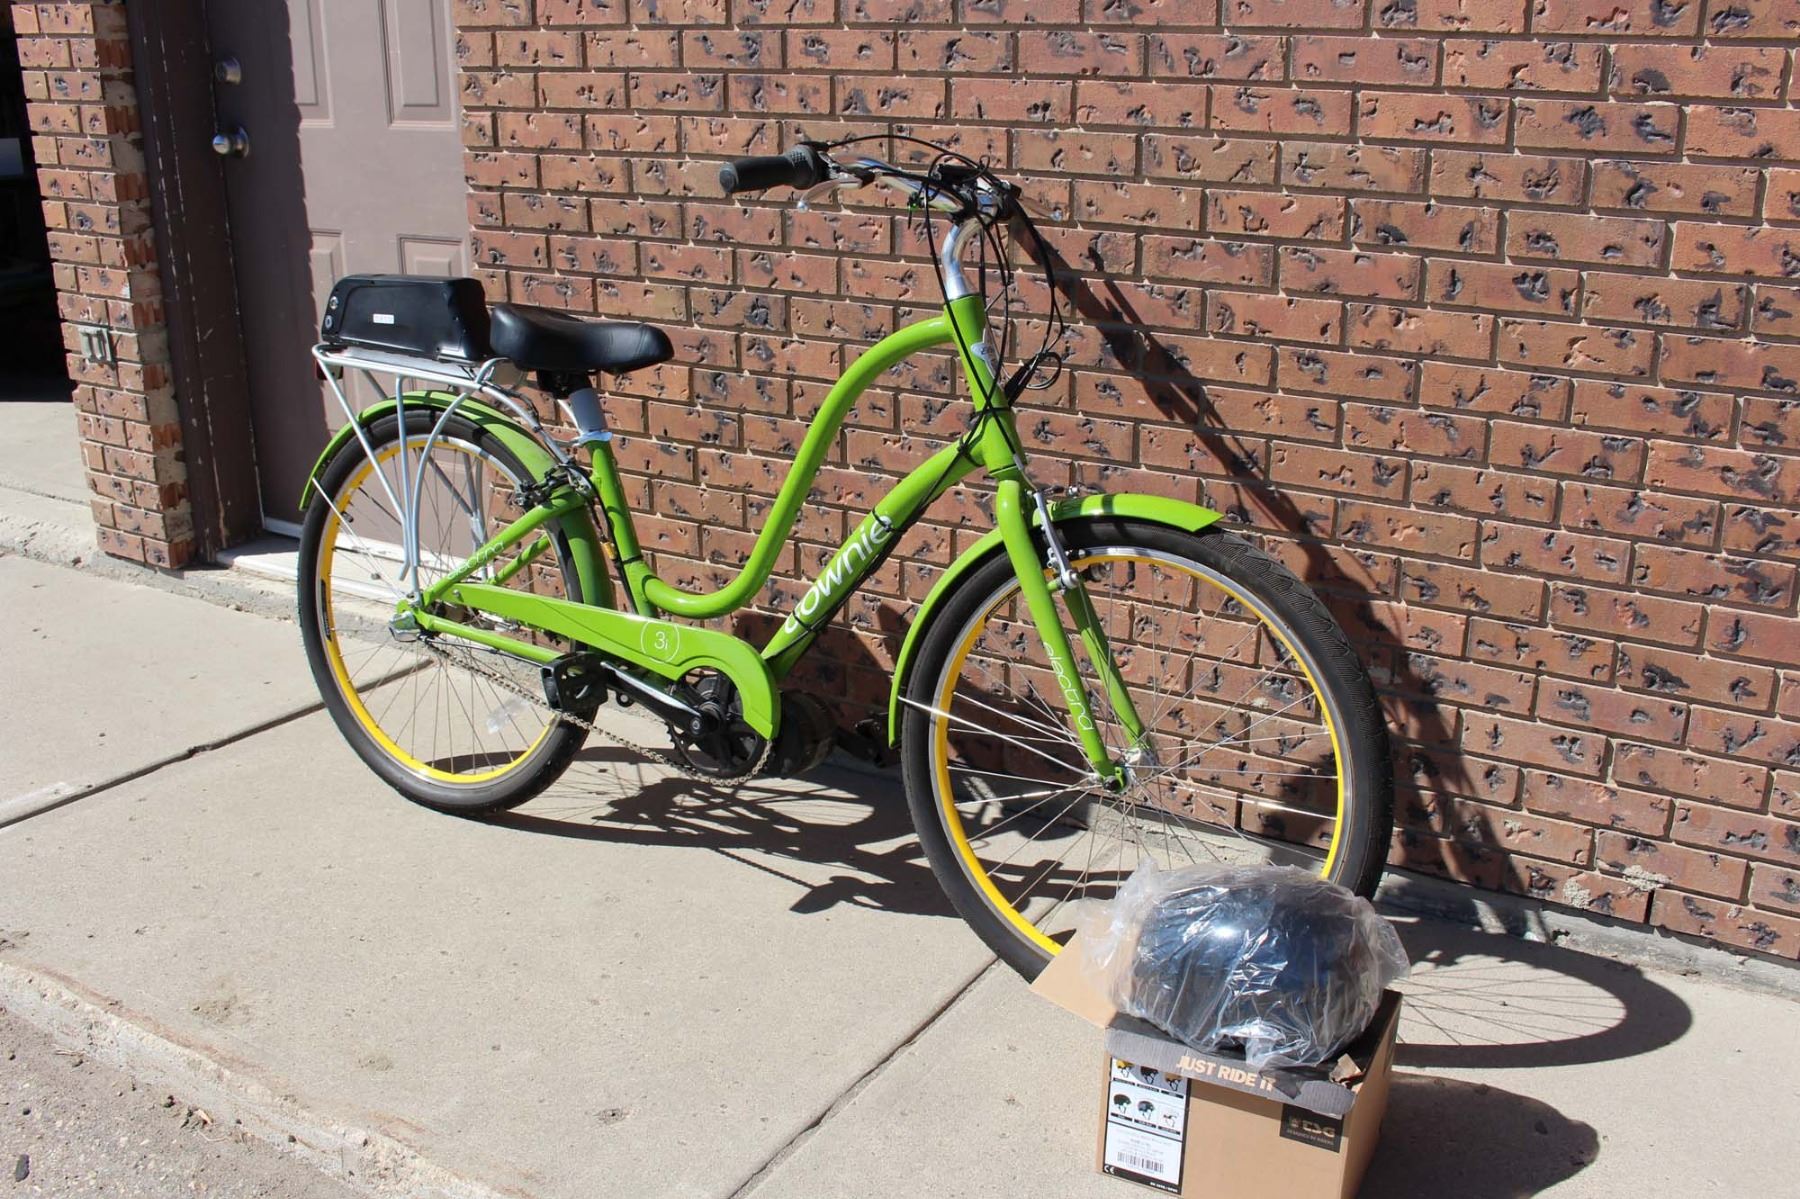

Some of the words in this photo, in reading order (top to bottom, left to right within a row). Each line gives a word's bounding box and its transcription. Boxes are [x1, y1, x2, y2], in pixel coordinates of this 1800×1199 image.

[1043, 642, 1095, 730] electra
[1176, 1055, 1217, 1076] JUST
[1217, 1065, 1258, 1087] RIDE
[1259, 1076, 1277, 1092] IT
